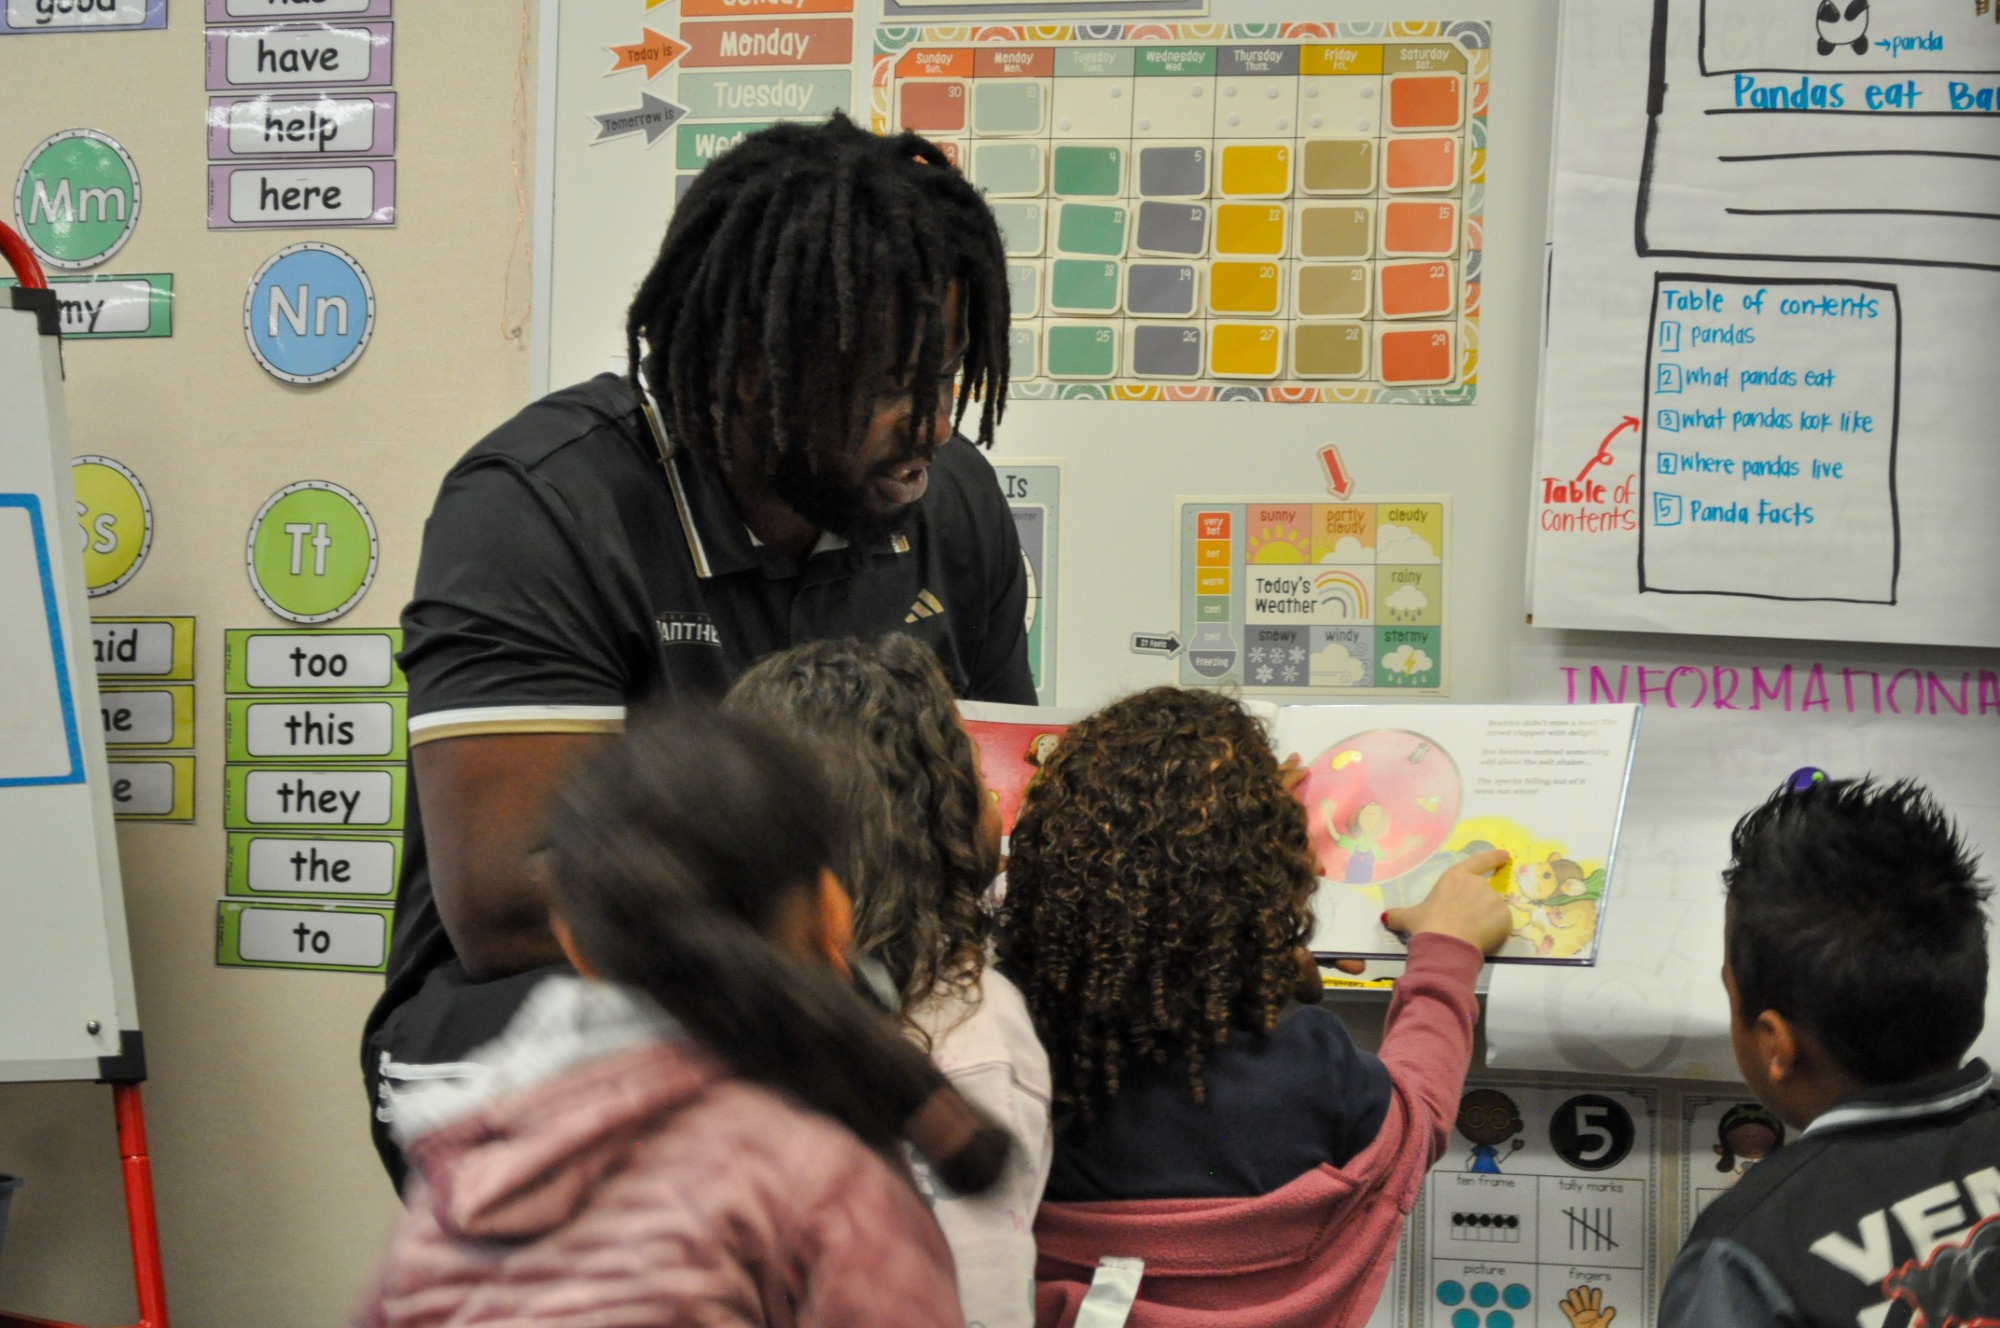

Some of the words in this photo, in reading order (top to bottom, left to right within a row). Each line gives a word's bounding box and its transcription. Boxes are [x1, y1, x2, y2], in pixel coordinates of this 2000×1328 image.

[720, 27, 810, 59] Monday
[1892, 31, 1943, 58] panda
[257, 39, 340, 73] have
[627, 47, 660, 63] Today
[662, 43, 673, 56] is
[916, 51, 953, 66] Sunday
[994, 51, 1034, 67] Monday
[1073, 50, 1116, 66] Tuesday
[1146, 49, 1205, 65] Wednesday
[1234, 49, 1283, 64] Thursday
[1324, 49, 1358, 64] Friday
[1401, 48, 1450, 62] Saturday
[925, 64, 943, 74] Sun.
[1003, 64, 1023, 73] Mon.
[1165, 62, 1185, 72] Wed.
[1245, 61, 1271, 71] Thurs.
[1333, 61, 1348, 71] Fri.
[1415, 60, 1434, 70] Sat.
[948, 86, 962, 98] 30
[1026, 87, 1037, 98] 31
[1450, 80, 1456, 92] 1
[1734, 74, 1844, 110] Pandas
[1865, 80, 1922, 110] eat
[1948, 81, 2000, 111] Ba
[714, 79, 814, 111] Tuesday
[604, 111, 661, 131] Tomorrow
[664, 107, 674, 121] is
[263, 108, 338, 152] help
[1029, 148, 1036, 160] 3
[1360, 144, 1368, 156] 7
[1444, 141, 1451, 153] 8
[1109, 151, 1116, 162] 4
[1194, 151, 1202, 162] 5
[1277, 149, 1285, 161] 6
[28, 178, 126, 224] Mm
[259, 177, 342, 211] here
[1026, 207, 1037, 219] 10
[1113, 211, 1122, 223] 11
[1190, 208, 1202, 221] 12
[1268, 209, 1280, 221] 13
[1353, 211, 1365, 223] 14
[1438, 206, 1450, 219] 15
[1021, 269, 1032, 281] 17
[1104, 264, 1115, 276] 18
[1179, 268, 1191, 281] 19
[1259, 266, 1275, 278] 20
[1351, 268, 1363, 281] 21
[1430, 266, 1445, 278] 22
[268, 284, 348, 337] Nn
[1662, 288, 1724, 313] Table
[1743, 288, 1767, 314] of
[1780, 293, 1879, 319] contents
[58, 299, 104, 332] my
[1017, 332, 1030, 344] 24
[1096, 330, 1110, 342] 25
[1182, 331, 1197, 343] 26
[1259, 329, 1276, 341] 27
[1346, 328, 1359, 341] 28
[1432, 333, 1446, 346] 29
[1691, 323, 1755, 347] pandas
[1741, 366, 1797, 392] pandas
[1805, 369, 1836, 388] eat
[1733, 407, 1793, 431] pandas
[1800, 411, 1833, 432] look
[1840, 411, 1874, 433] like
[1742, 455, 1800, 481] pandas
[1812, 458, 1843, 479] live
[1542, 477, 1607, 505] Table
[1613, 474, 1635, 505] of
[1260, 510, 1296, 523] sunny
[1327, 509, 1365, 522] partly
[1389, 509, 1428, 522] cloudy
[1690, 500, 1749, 525] Panda
[1204, 518, 1224, 527] very
[1327, 522, 1366, 535] cloudy
[1206, 526, 1220, 535] hot
[284, 522, 332, 576] Tt
[1206, 549, 1220, 558] hot
[1202, 577, 1224, 586] warm
[1392, 569, 1422, 585] rainy
[1256, 576, 1311, 596] Today's
[1204, 604, 1221, 613] cool
[1255, 598, 1318, 613] Weather
[1258, 629, 1297, 643] snowy
[1325, 628, 1360, 643] windy
[1385, 629, 1429, 643] stormy
[290, 647, 347, 678] too
[285, 714, 354, 745] this
[277, 779, 360, 824] they
[290, 848, 351, 881] the
[293, 922, 331, 953] to
[1575, 1106, 1613, 1161] 5
[1456, 1174, 1477, 1187] ten
[1479, 1175, 1515, 1189] frame
[1559, 1178, 1583, 1193] tally
[1587, 1180, 1624, 1194] marks
[1463, 1263, 1505, 1277] picture
[1568, 1266, 1612, 1282] fingers
